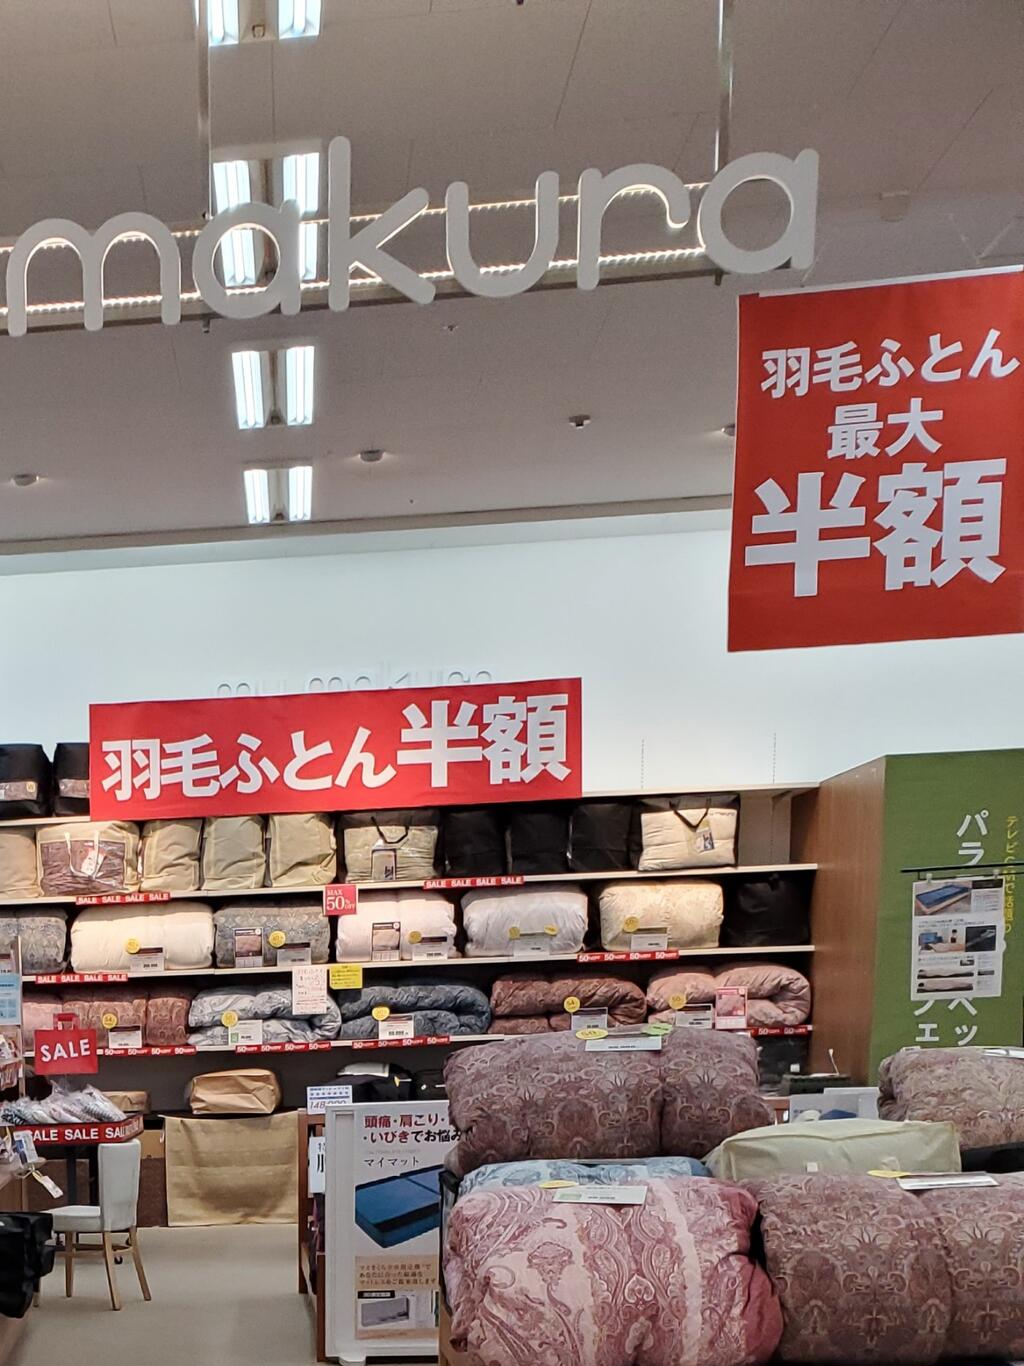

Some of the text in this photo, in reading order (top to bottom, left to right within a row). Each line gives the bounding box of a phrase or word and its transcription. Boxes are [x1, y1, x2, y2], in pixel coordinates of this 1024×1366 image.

[5, 135, 819, 337] makura
[760, 328, 1021, 399] 羽毛ふとん
[827, 397, 944, 460] 最大
[744, 457, 1008, 598] 半額
[40, 1039, 91, 1062] SALE
[29, 1129, 58, 1141] ALE
[64, 1128, 99, 1141] SALE
